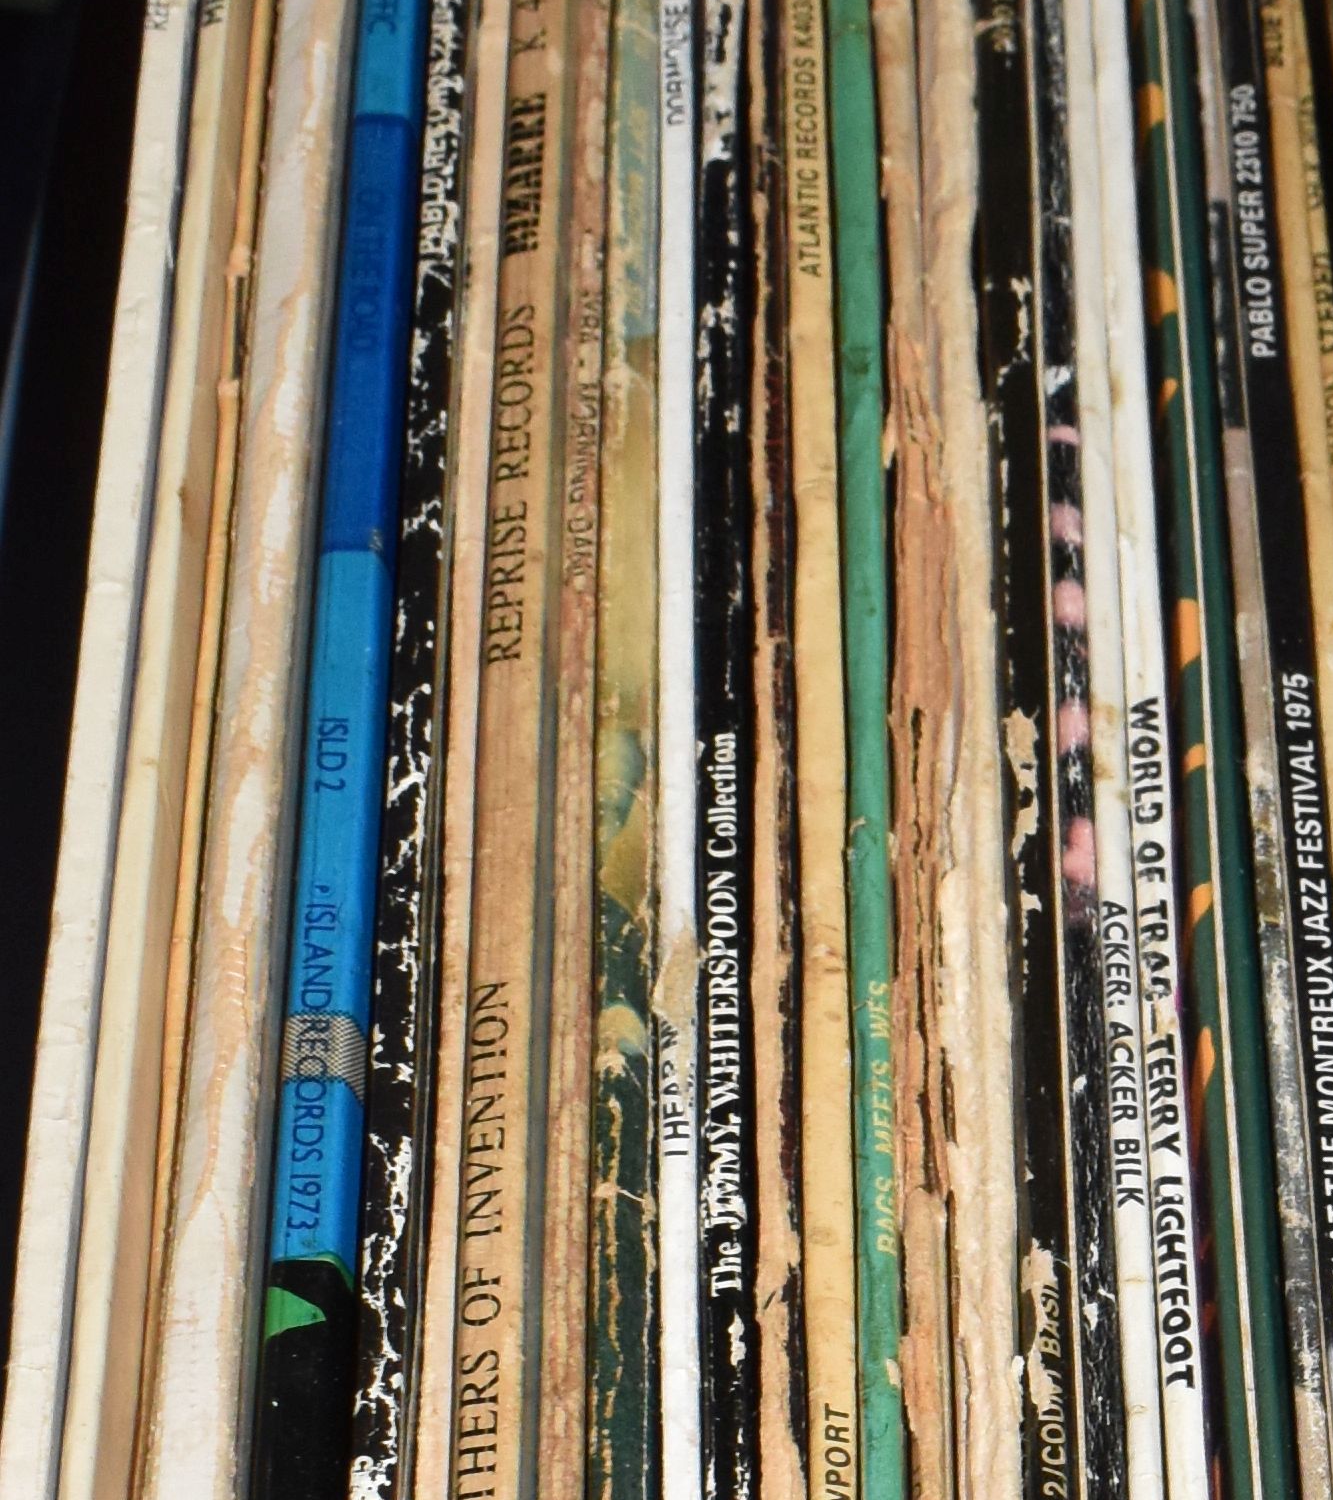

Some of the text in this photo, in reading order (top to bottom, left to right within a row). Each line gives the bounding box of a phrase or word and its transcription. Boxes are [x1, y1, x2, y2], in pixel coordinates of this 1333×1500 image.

[792, 55, 823, 278] ATLANTIC RECORDS
[1229, 82, 1279, 358] PABLO SUPER 2310 750
[495, 303, 535, 480] RECORDS
[486, 497, 527, 664] REPRISE
[314, 715, 349, 770] ISLD
[1282, 671, 1313, 731] 1975
[1288, 737, 1326, 869] FESTIVAL
[298, 902, 337, 1009] ISLAND
[710, 730, 742, 1103] WHITERSPOON Collection
[1299, 876, 1333, 947] JAZZ
[466, 977, 511, 1238] INVENTION
[1107, 1019, 1146, 1206] ACKER BILK
[463, 1262, 503, 1326] OF
[1153, 1174, 1196, 1387] LIGHTFOOT
